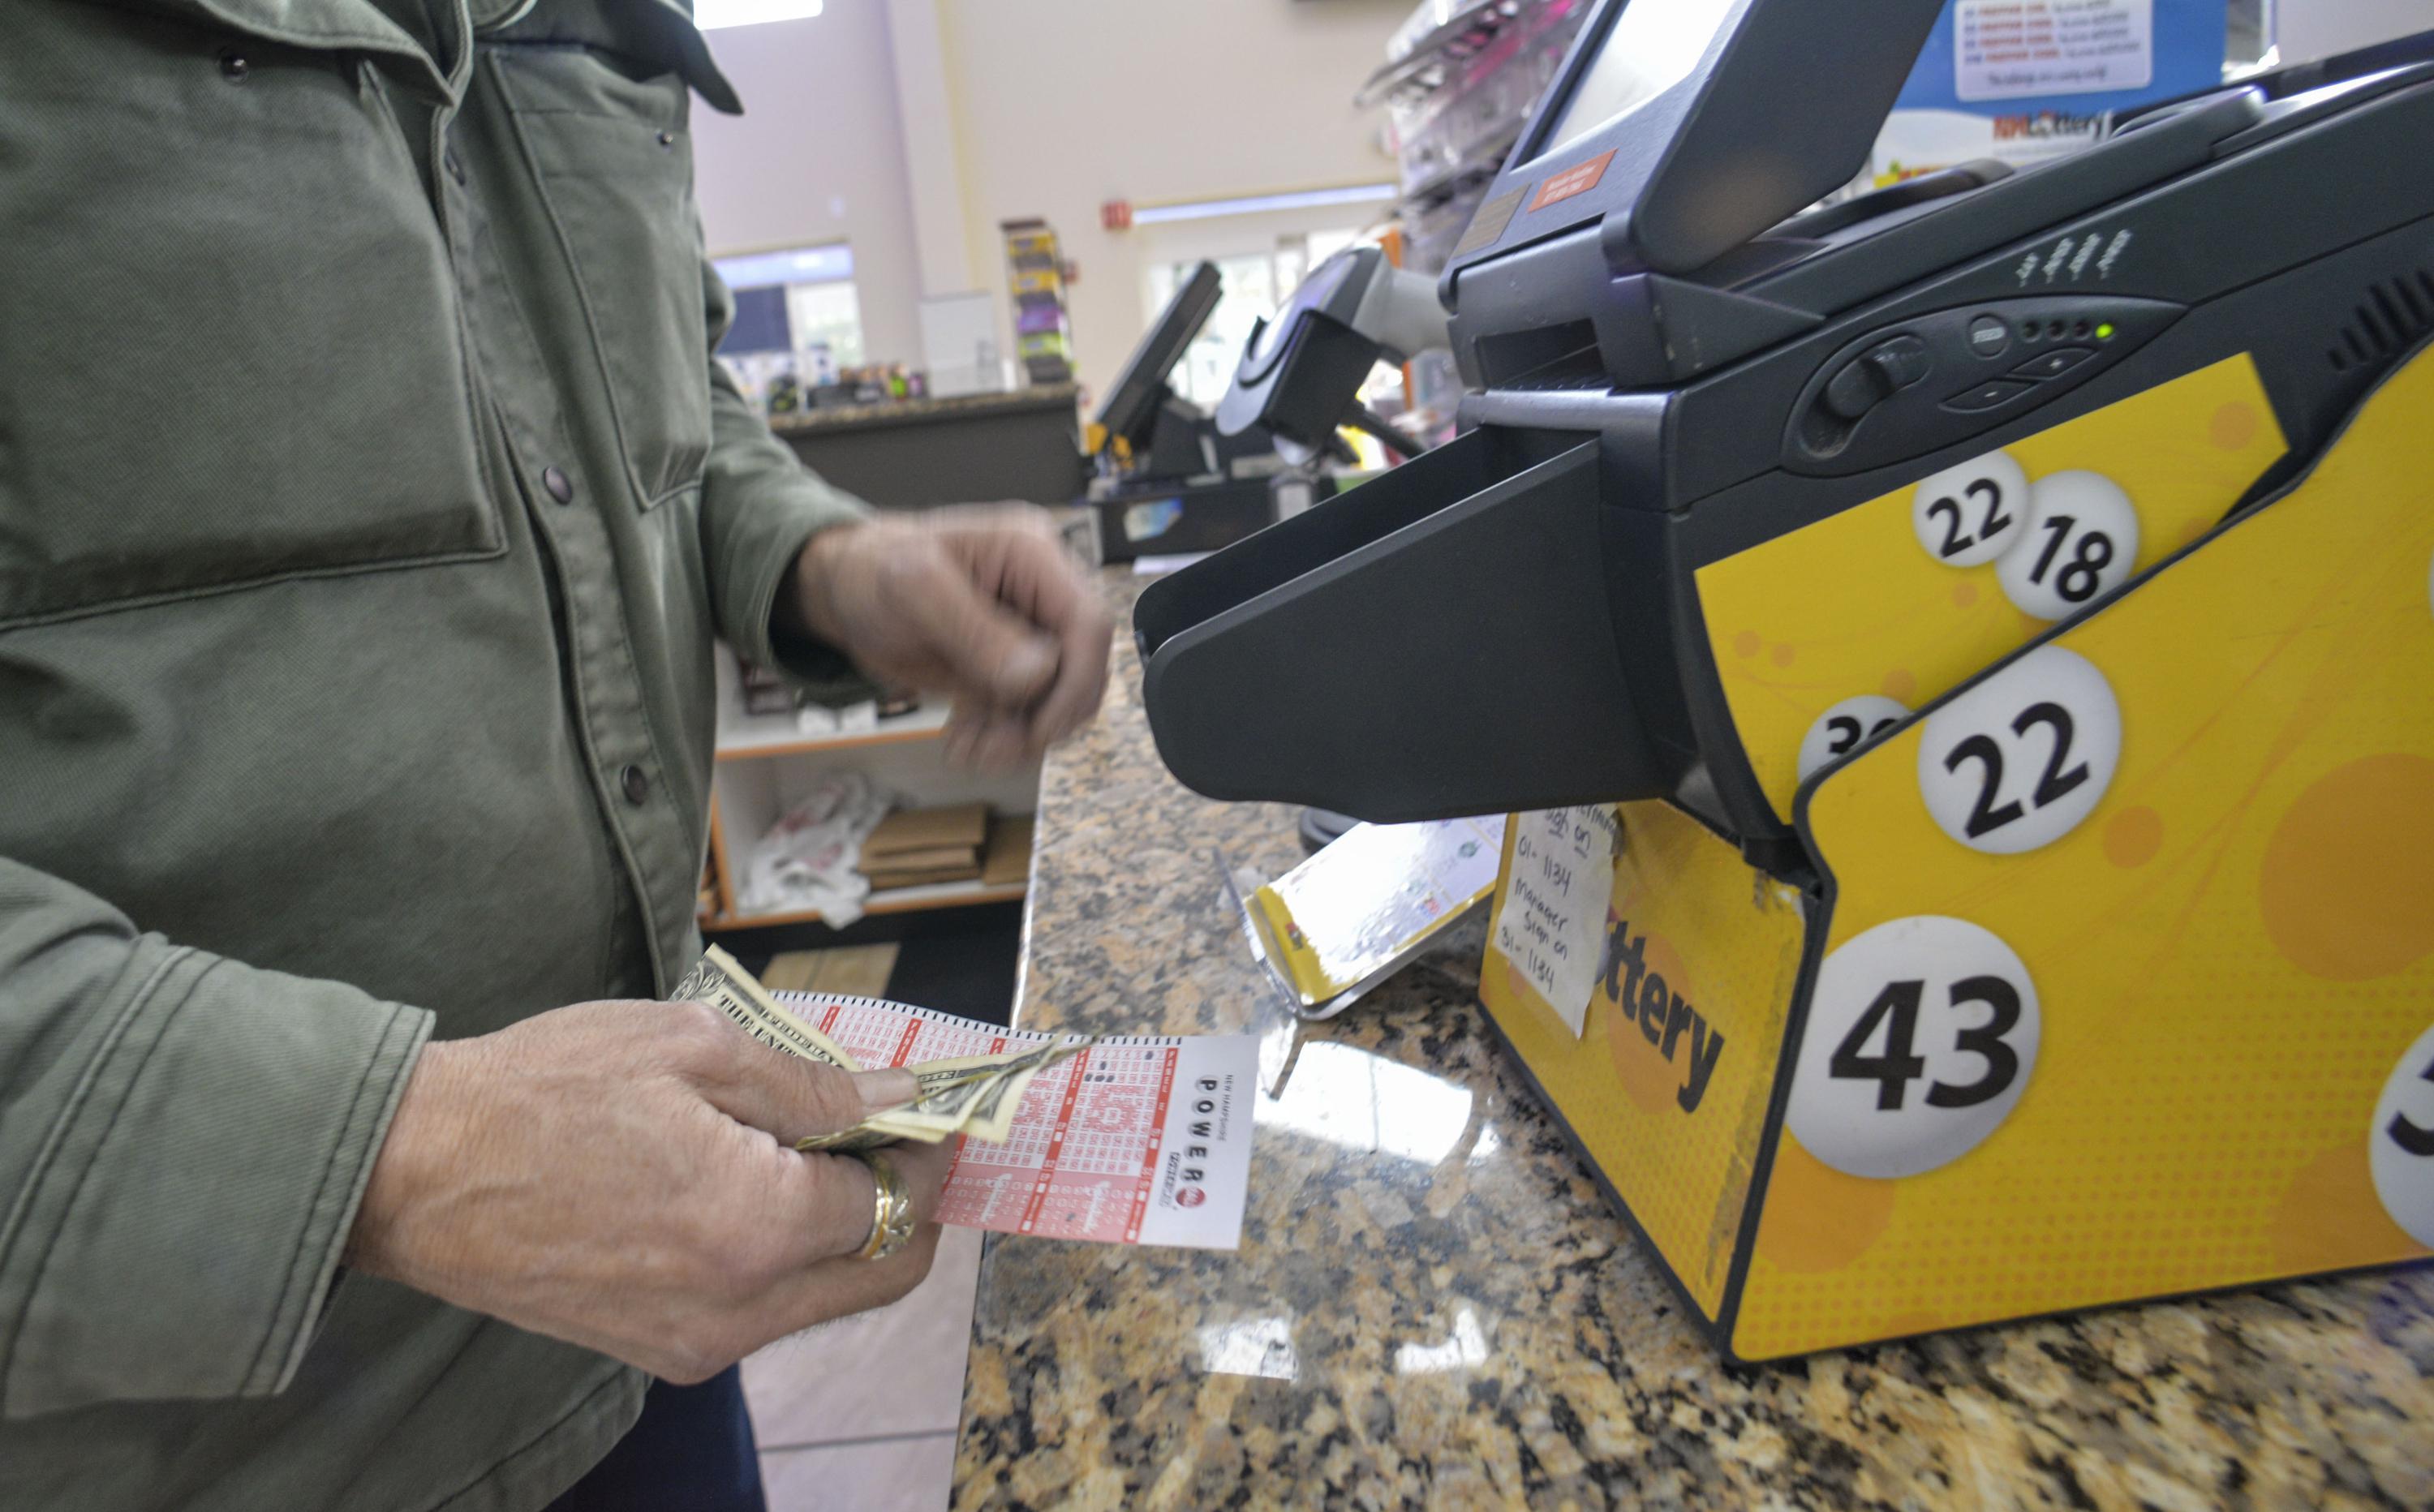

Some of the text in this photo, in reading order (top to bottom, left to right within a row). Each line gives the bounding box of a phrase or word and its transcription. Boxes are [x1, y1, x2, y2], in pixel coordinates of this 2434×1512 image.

[1925, 478, 2012, 558] 22
[2028, 515, 2113, 604] 18
[1826, 715, 1899, 755] 3
[1943, 702, 2090, 840] 22
[1543, 856, 1572, 897] 1134
[1528, 949, 1555, 994] 1134
[1595, 920, 1726, 1114] ttery
[1828, 975, 2021, 1111] 43
